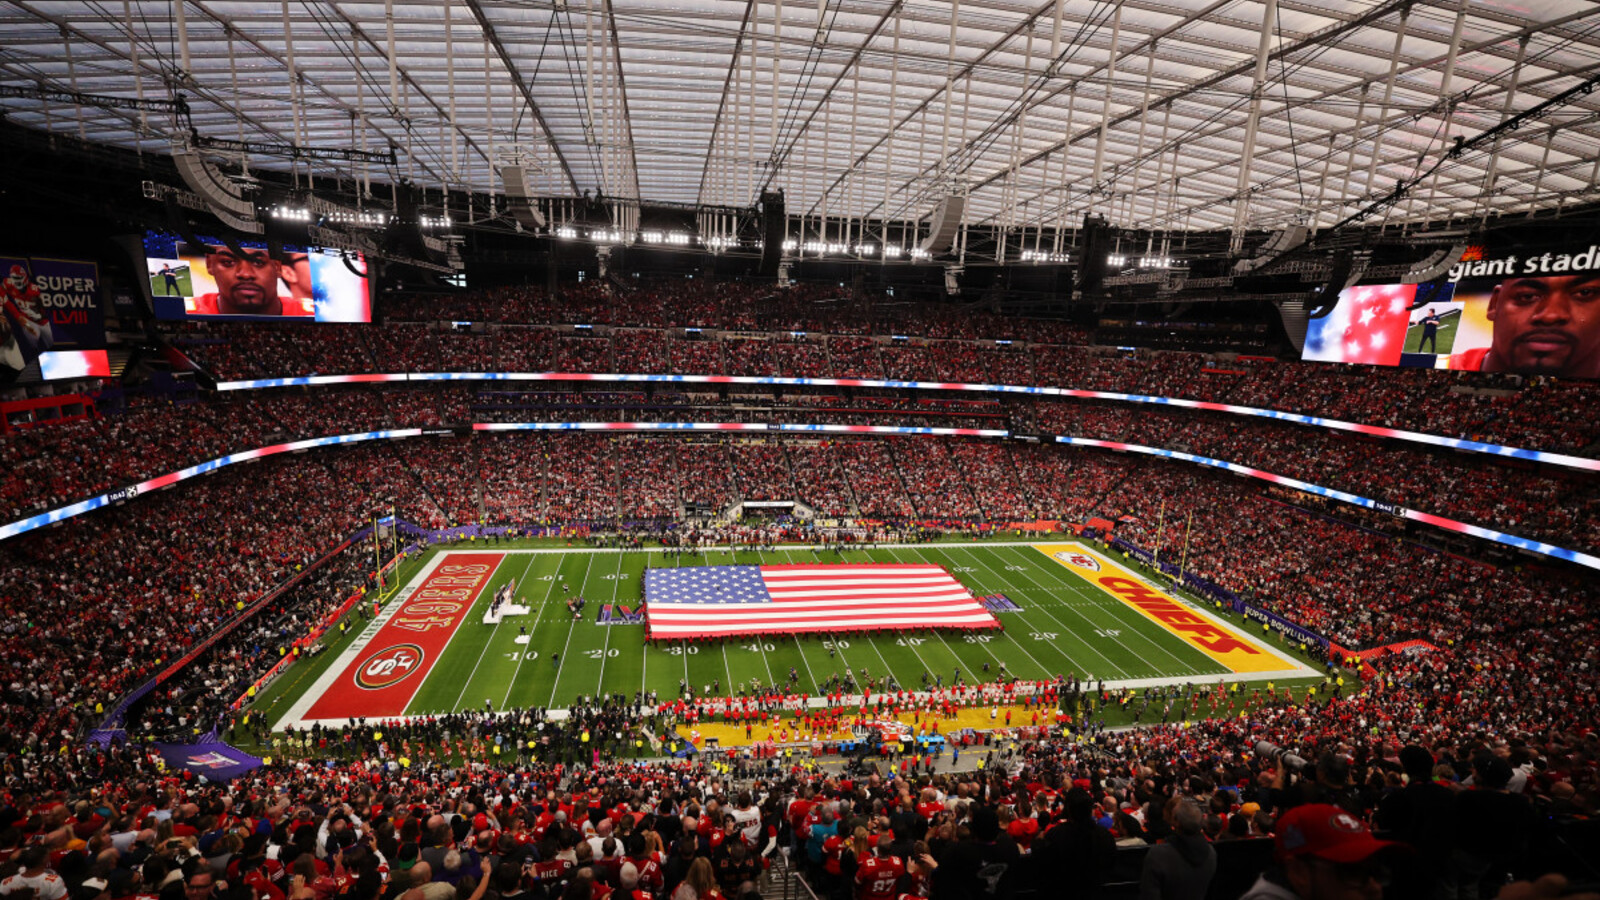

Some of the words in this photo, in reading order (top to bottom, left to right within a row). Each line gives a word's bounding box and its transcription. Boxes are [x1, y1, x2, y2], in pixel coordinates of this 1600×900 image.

[36, 275, 96, 293] SUPER
[41, 292, 97, 309] BOWL
[52, 309, 88, 324] LVIII
[392, 563, 491, 632] 49ERS
[1098, 576, 1262, 655] CHIEFS
[1245, 606, 1269, 622] SUPER
[1270, 618, 1296, 637] BOWL
[1029, 631, 1056, 641] 20
[1094, 628, 1120, 638] 10
[896, 637, 922, 647] 40
[963, 634, 990, 644] 30
[670, 645, 699, 656] 30
[746, 643, 776, 653] 40
[822, 640, 850, 650] 50
[508, 650, 539, 661] 10
[589, 648, 620, 659] 20
[540, 869, 559, 879] RICE
[872, 878, 897, 892] 87
